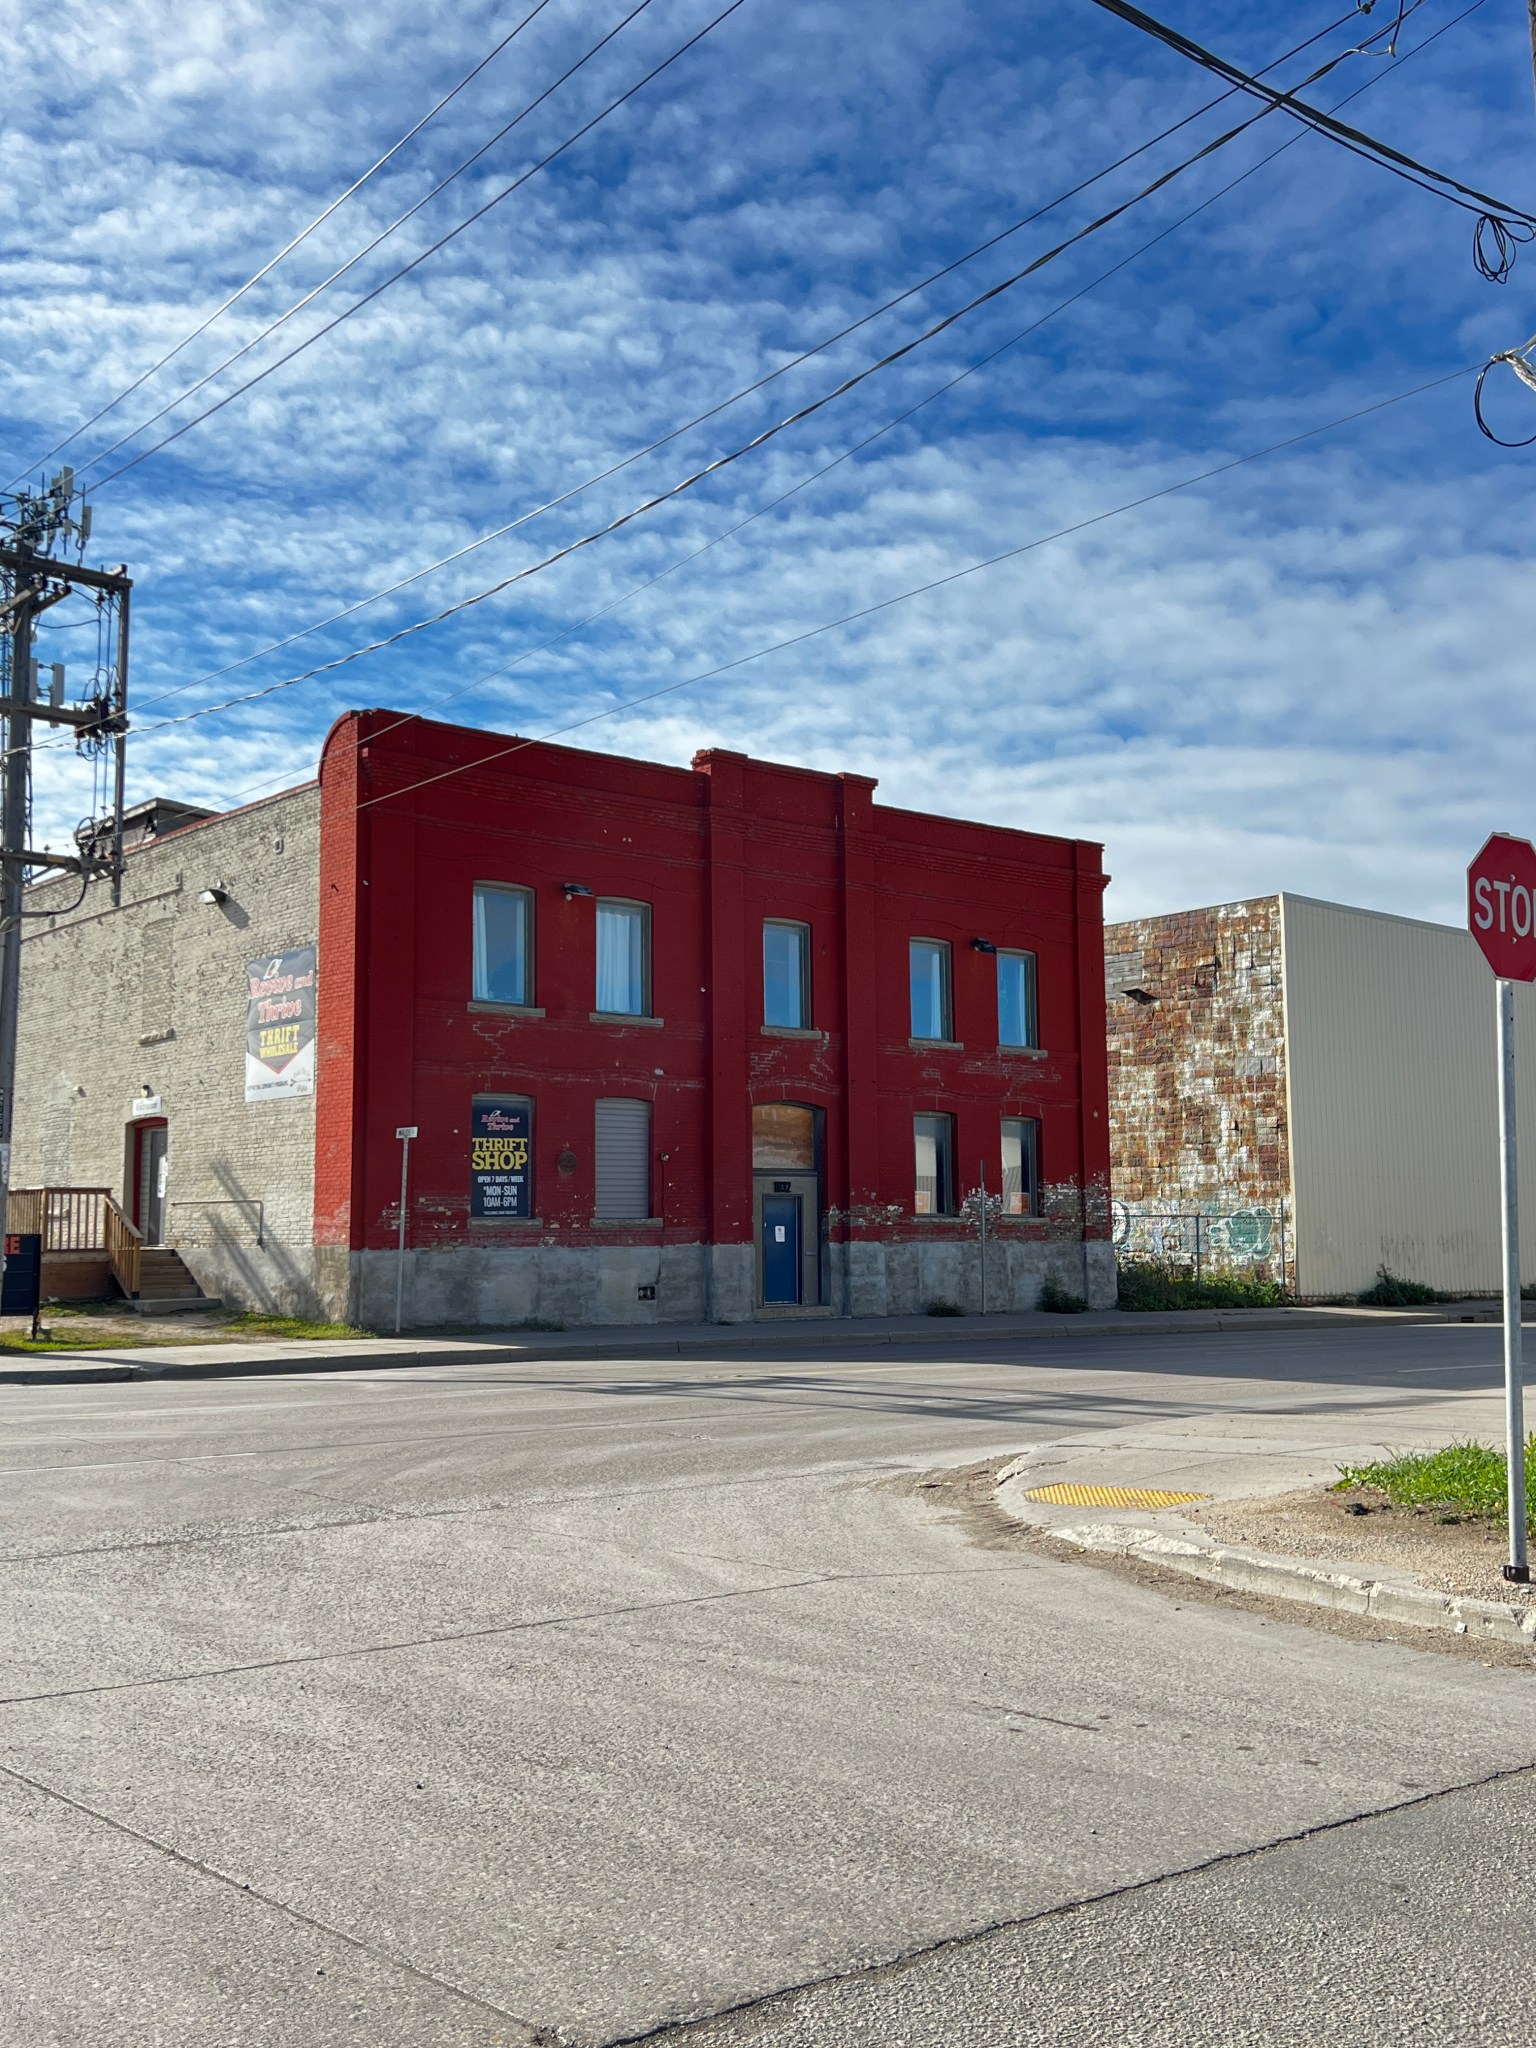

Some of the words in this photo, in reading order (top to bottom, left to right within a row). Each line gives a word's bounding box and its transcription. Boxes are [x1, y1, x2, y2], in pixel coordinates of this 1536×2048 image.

[249, 974, 293, 999] Revive
[294, 970, 314, 989] and
[258, 996, 302, 1024] Thrive
[260, 1024, 300, 1047] THRIFT
[260, 1042, 299, 1059] WHOLESALE
[472, 1137, 528, 1151] THRIFT
[472, 1151, 528, 1170] SHOP
[477, 1175, 491, 1183] OPEN
[491, 1175, 495, 1183] 7
[483, 1197, 517, 1207] 10AM-6PM
